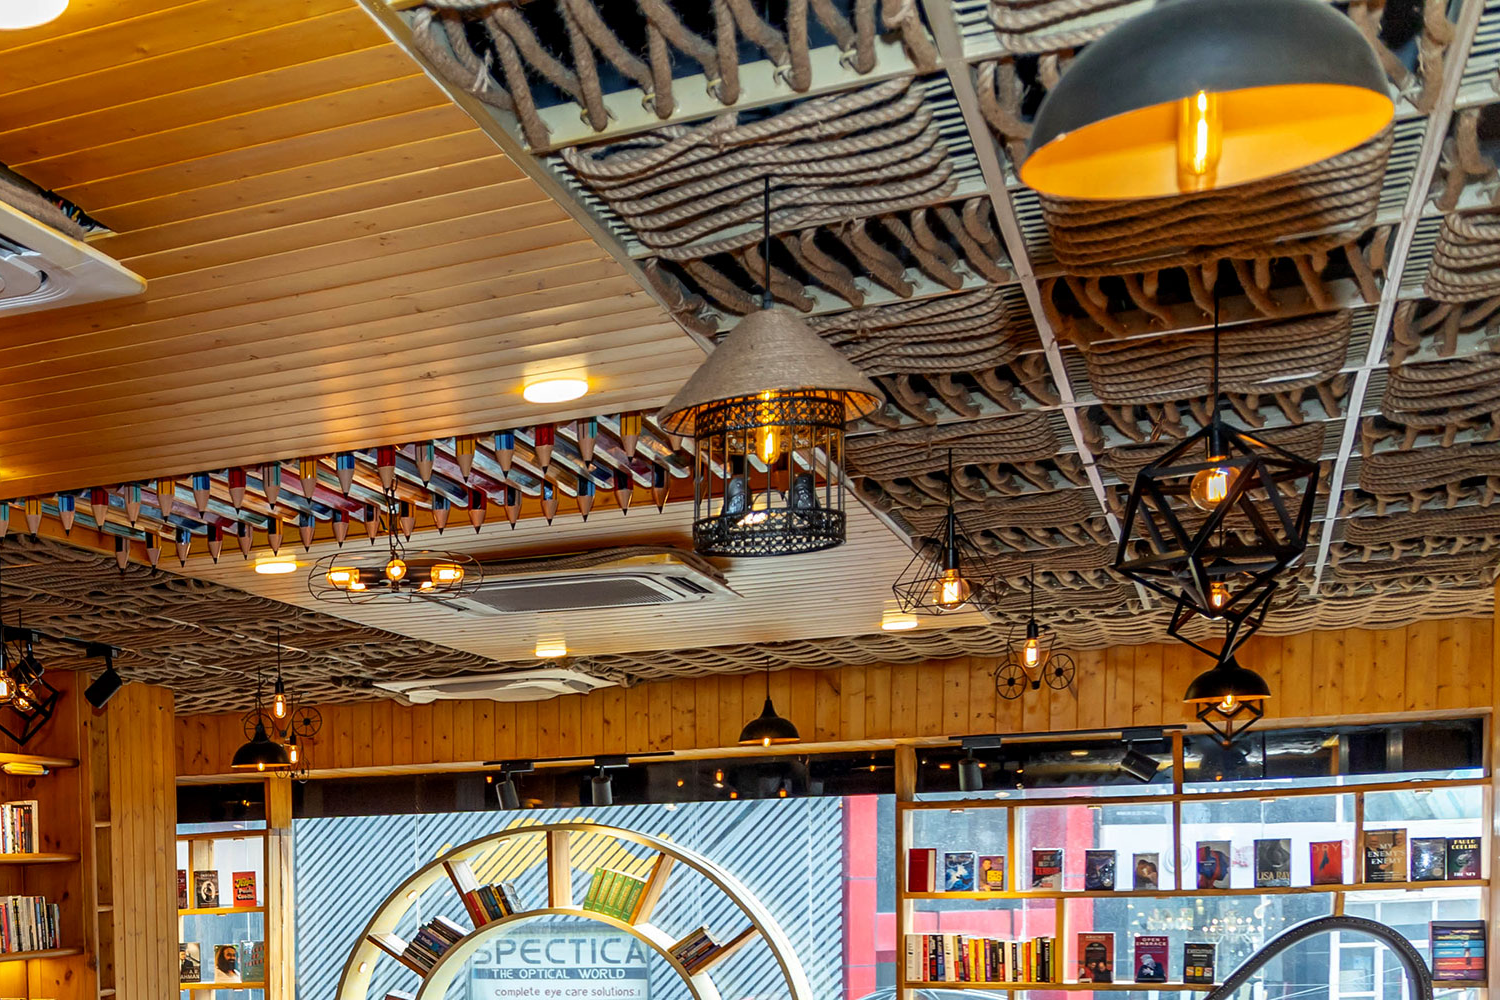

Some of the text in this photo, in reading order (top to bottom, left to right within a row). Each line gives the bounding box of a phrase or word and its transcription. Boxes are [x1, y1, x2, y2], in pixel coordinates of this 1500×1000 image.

[1311, 843, 1340, 852] DRY
[1371, 857, 1403, 865] ENEMY
[1256, 871, 1275, 881] LISA
[474, 938, 648, 965] SPECTICA
[491, 969, 626, 980] THE OPTICAL WORLD
[494, 986, 541, 997] complete
[544, 989, 562, 998] eye
[565, 988, 589, 997] care
